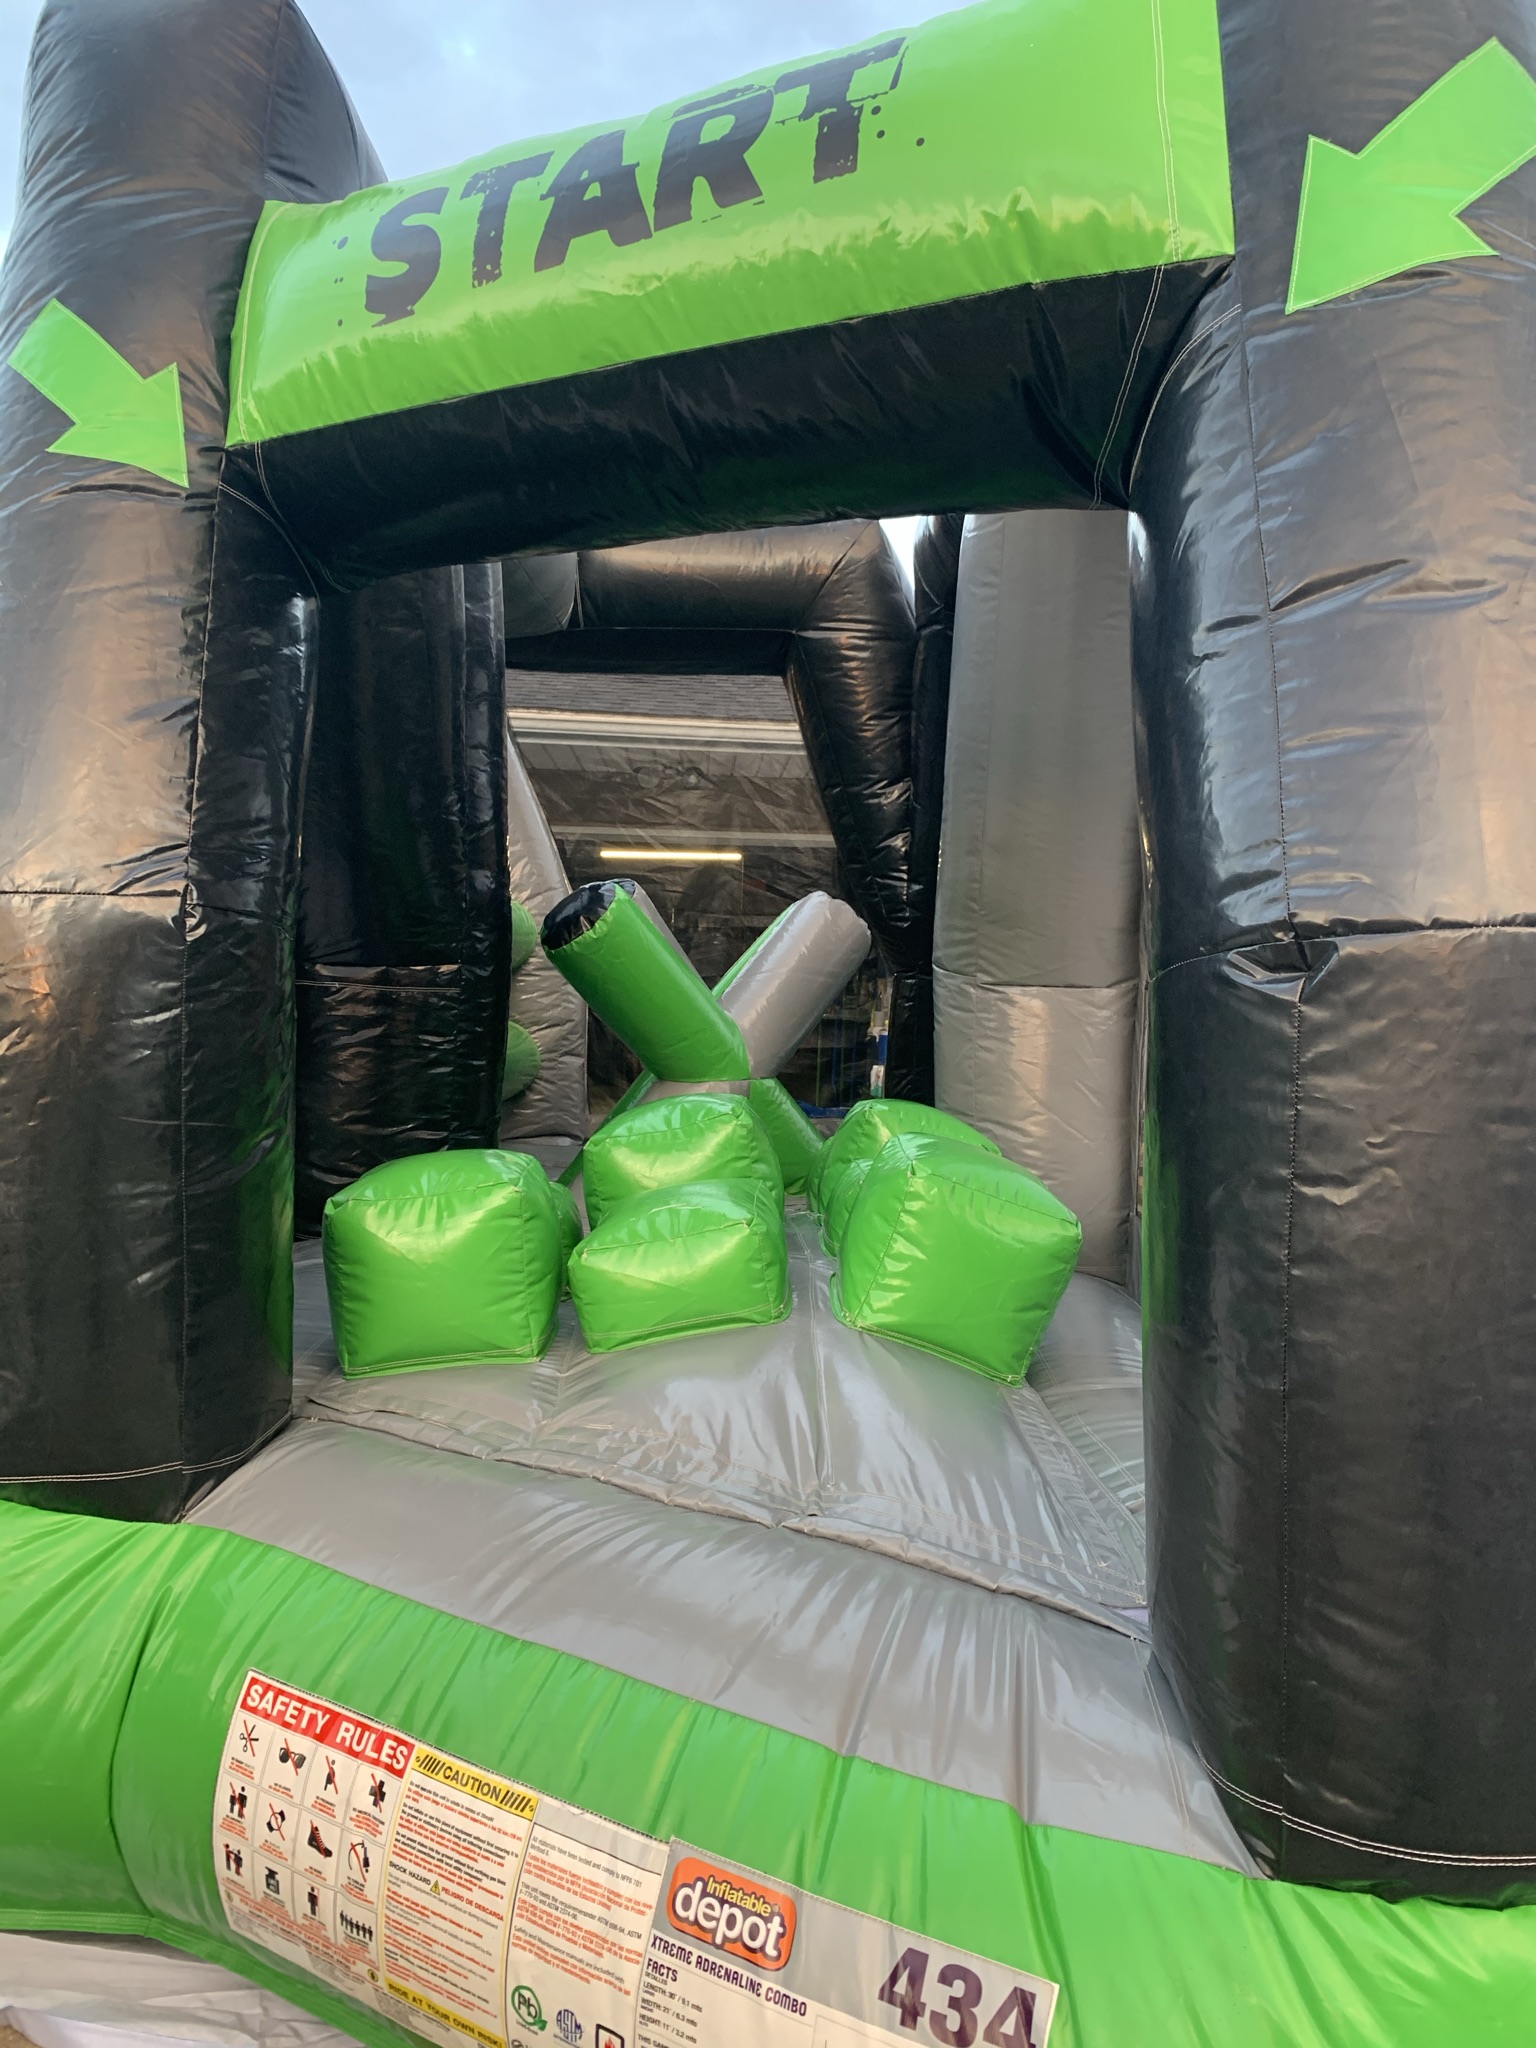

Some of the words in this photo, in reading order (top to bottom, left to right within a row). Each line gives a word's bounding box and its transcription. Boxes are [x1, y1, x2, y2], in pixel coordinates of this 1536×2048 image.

[365, 37, 908, 327] START
[247, 1684, 331, 1735] SAFETY
[336, 1722, 409, 1771] RULES
[442, 1767, 502, 1804] CAUTION
[389, 1861, 408, 1875] SHOCK
[408, 1870, 431, 1886] HAZARD
[539, 1838, 557, 1851] materials
[557, 1847, 567, 1856] have
[568, 1851, 578, 1860] been
[578, 1855, 592, 1867] tested
[601, 1866, 615, 1878] comply
[621, 1873, 633, 1884] NFPA
[441, 1886, 464, 1903] PELIGRO
[466, 1898, 474, 1907] DE
[474, 1902, 505, 1922] DESCARGA
[547, 1902, 559, 1912] ASTM
[707, 1877, 772, 1917] Inflatable
[597, 1916, 609, 1926] ASTM
[628, 1929, 642, 1941] ASTM
[675, 1881, 783, 1957] depot
[644, 1972, 668, 1986] DETALLES
[646, 1958, 678, 1983] FACTS
[651, 1935, 693, 1965] XTREME
[695, 1955, 762, 1998] ADRENALINE
[764, 1987, 808, 2017] COMBO
[517, 1990, 538, 2020] Pb
[641, 1997, 662, 2010] WIDTH:
[643, 1981, 667, 1997] LENGTH:
[877, 1947, 1037, 2048] 434
[388, 1983, 410, 2000] RIDE
[412, 1996, 423, 2007] AT
[426, 2003, 451, 2023] YOUR
[453, 2018, 475, 2035] OWN
[639, 2013, 661, 2027] HEIGHT:
[637, 2034, 651, 2045] THIS
